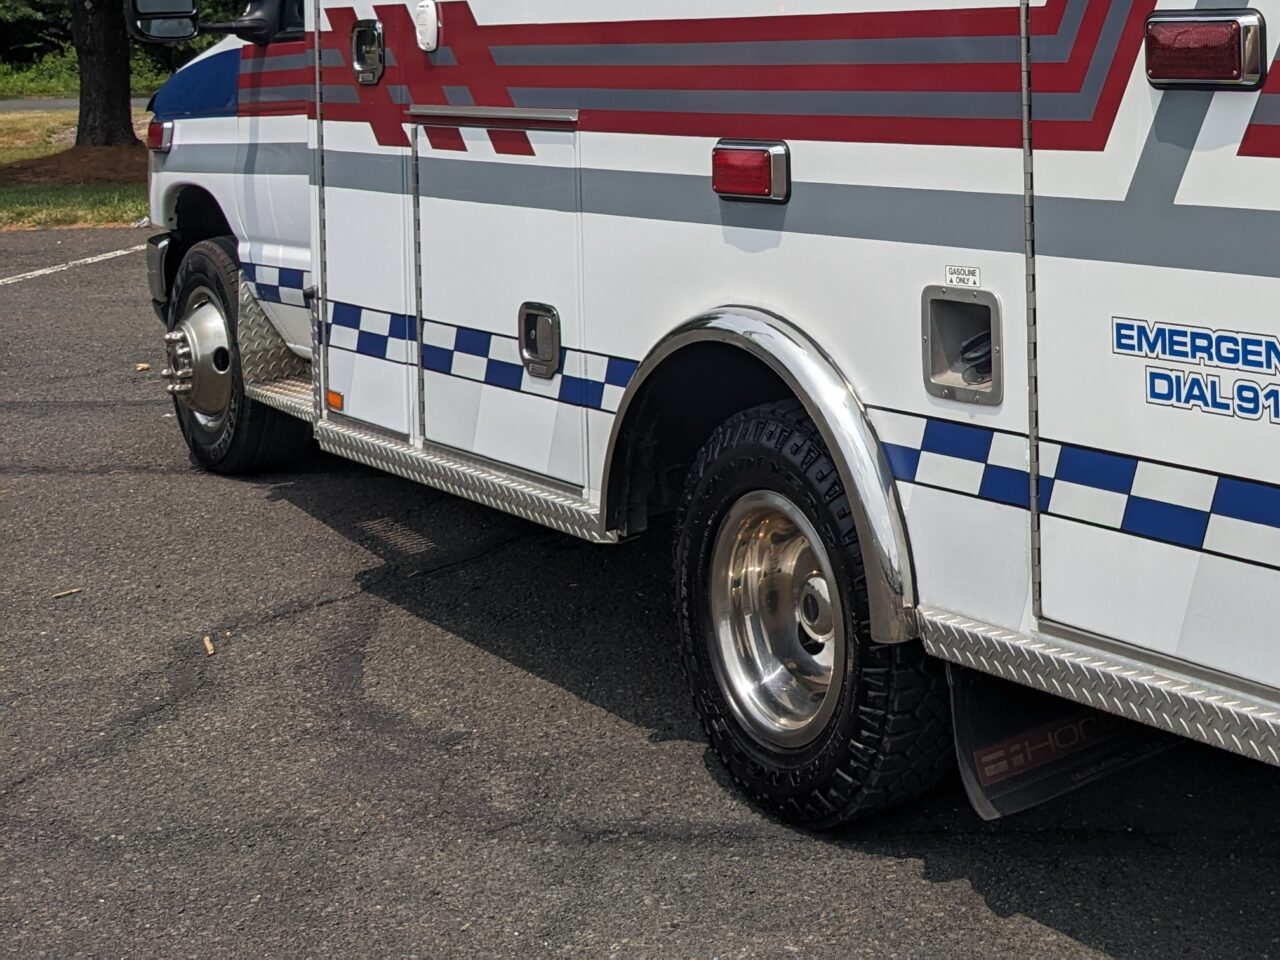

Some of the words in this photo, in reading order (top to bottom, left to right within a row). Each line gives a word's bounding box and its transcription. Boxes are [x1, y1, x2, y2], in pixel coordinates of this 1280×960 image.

[948, 267, 977, 277] GASOLINE
[955, 276, 970, 285] ONLY
[1148, 368, 1232, 414] DIAL
